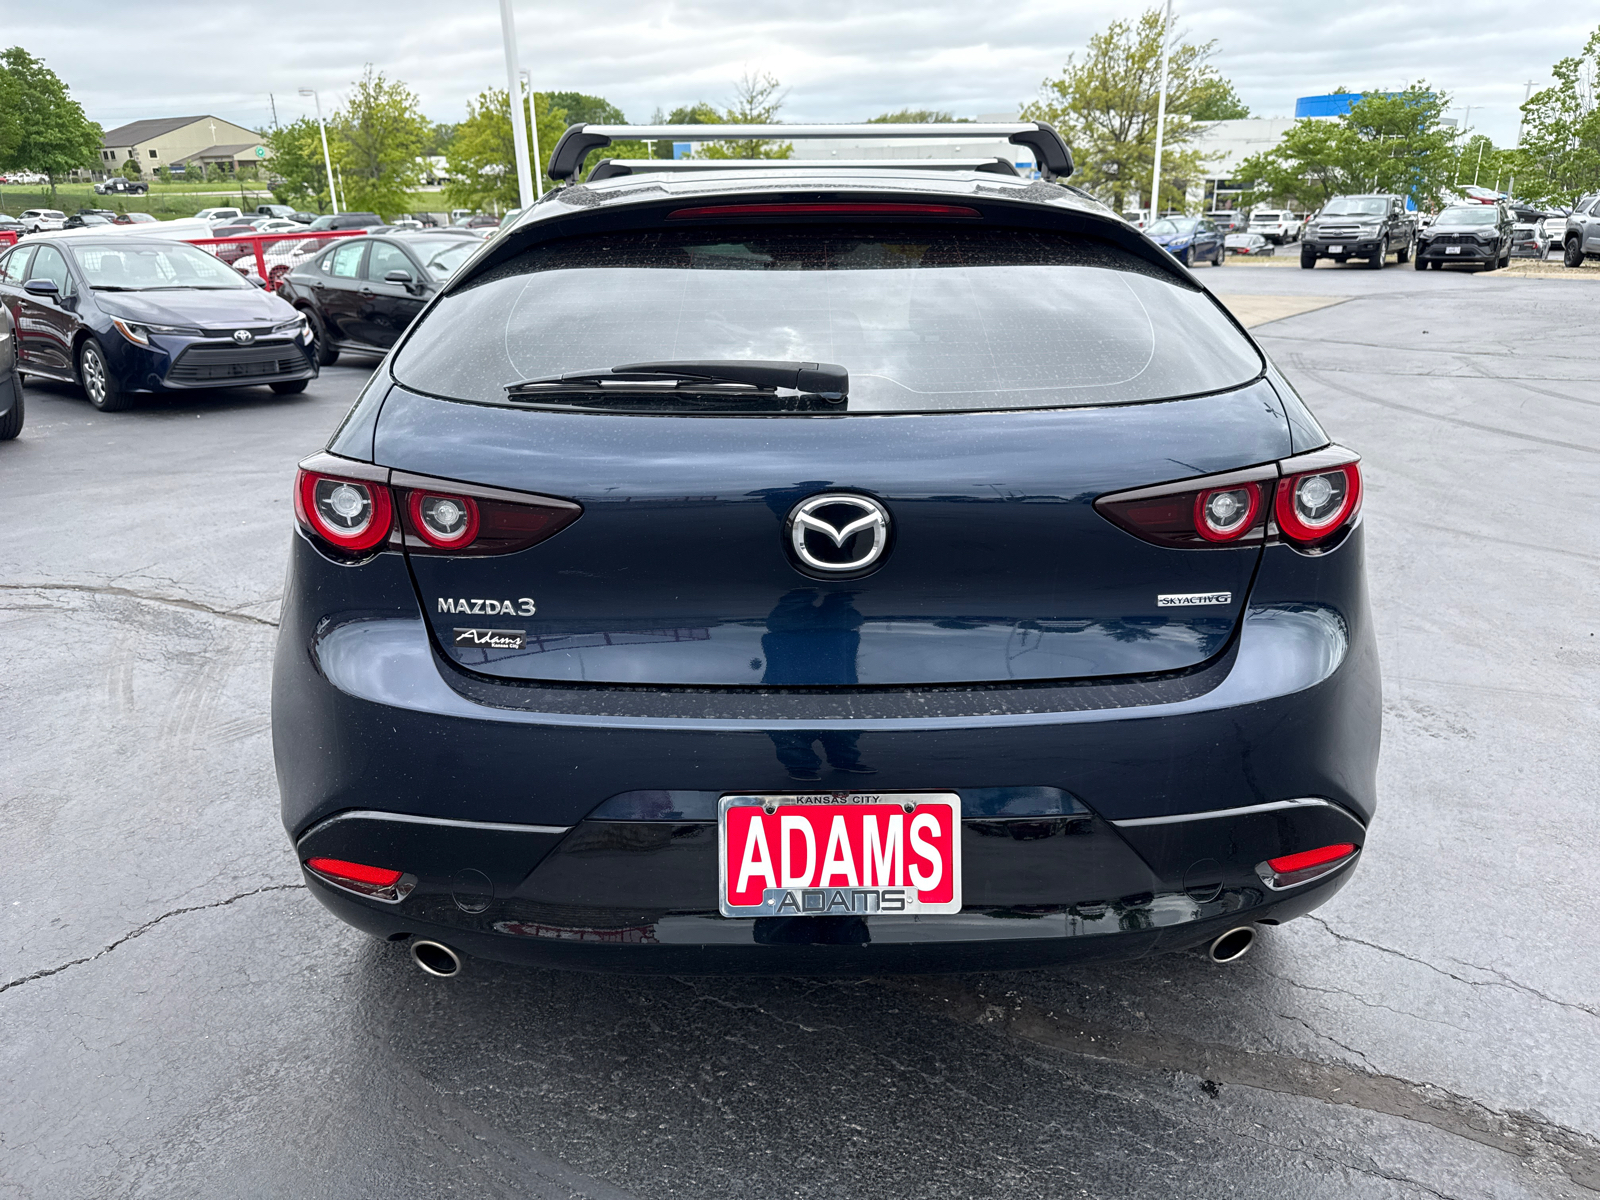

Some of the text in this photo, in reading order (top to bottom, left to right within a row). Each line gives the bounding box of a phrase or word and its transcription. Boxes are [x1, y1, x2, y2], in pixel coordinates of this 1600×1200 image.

[456, 629, 522, 644] Adams
[796, 796, 880, 804] KANSAS CITY
[735, 813, 943, 893] ADAMS
[777, 890, 905, 912] ADAMS
